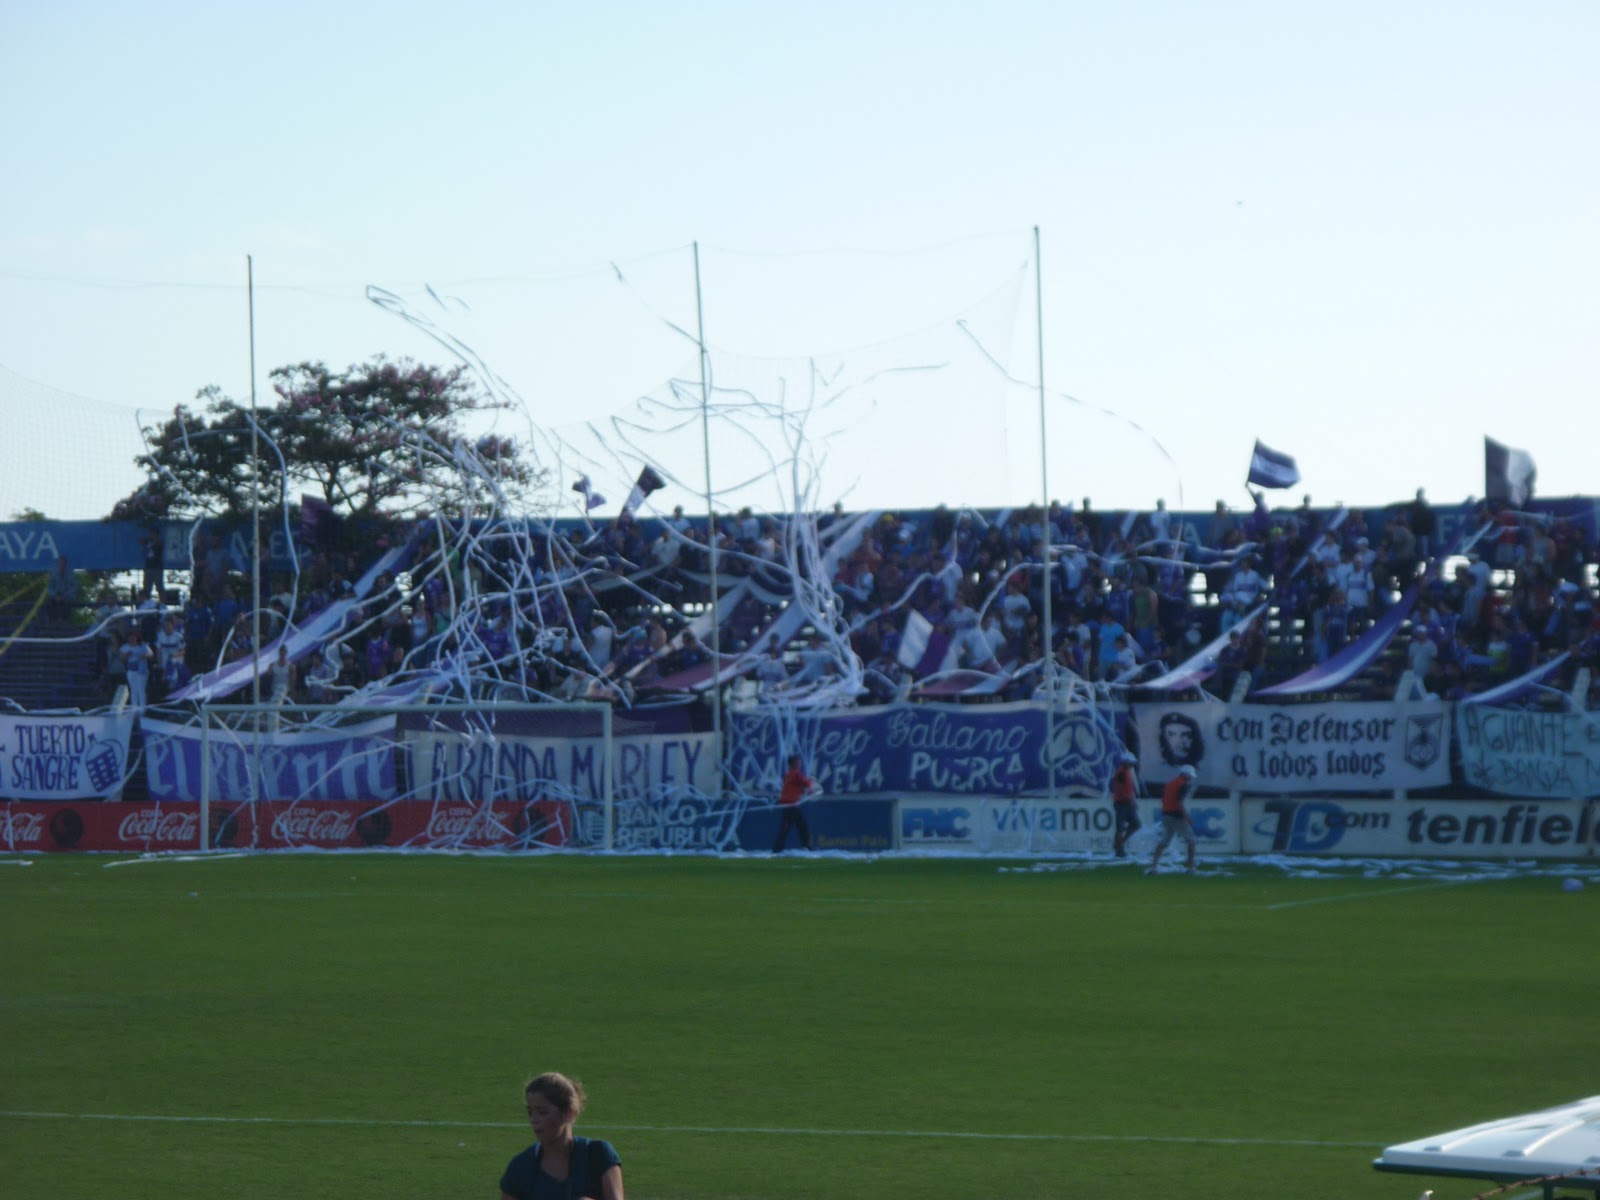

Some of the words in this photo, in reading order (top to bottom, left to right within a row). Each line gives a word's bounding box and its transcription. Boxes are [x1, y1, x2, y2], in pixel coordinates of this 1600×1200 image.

[15, 724, 85, 754] TUERTO
[1217, 715, 1263, 742] con
[1270, 711, 1396, 746] Defensor
[12, 755, 80, 790] SANGRE
[571, 740, 703, 800] MRLEY
[617, 804, 698, 826] BANCO
